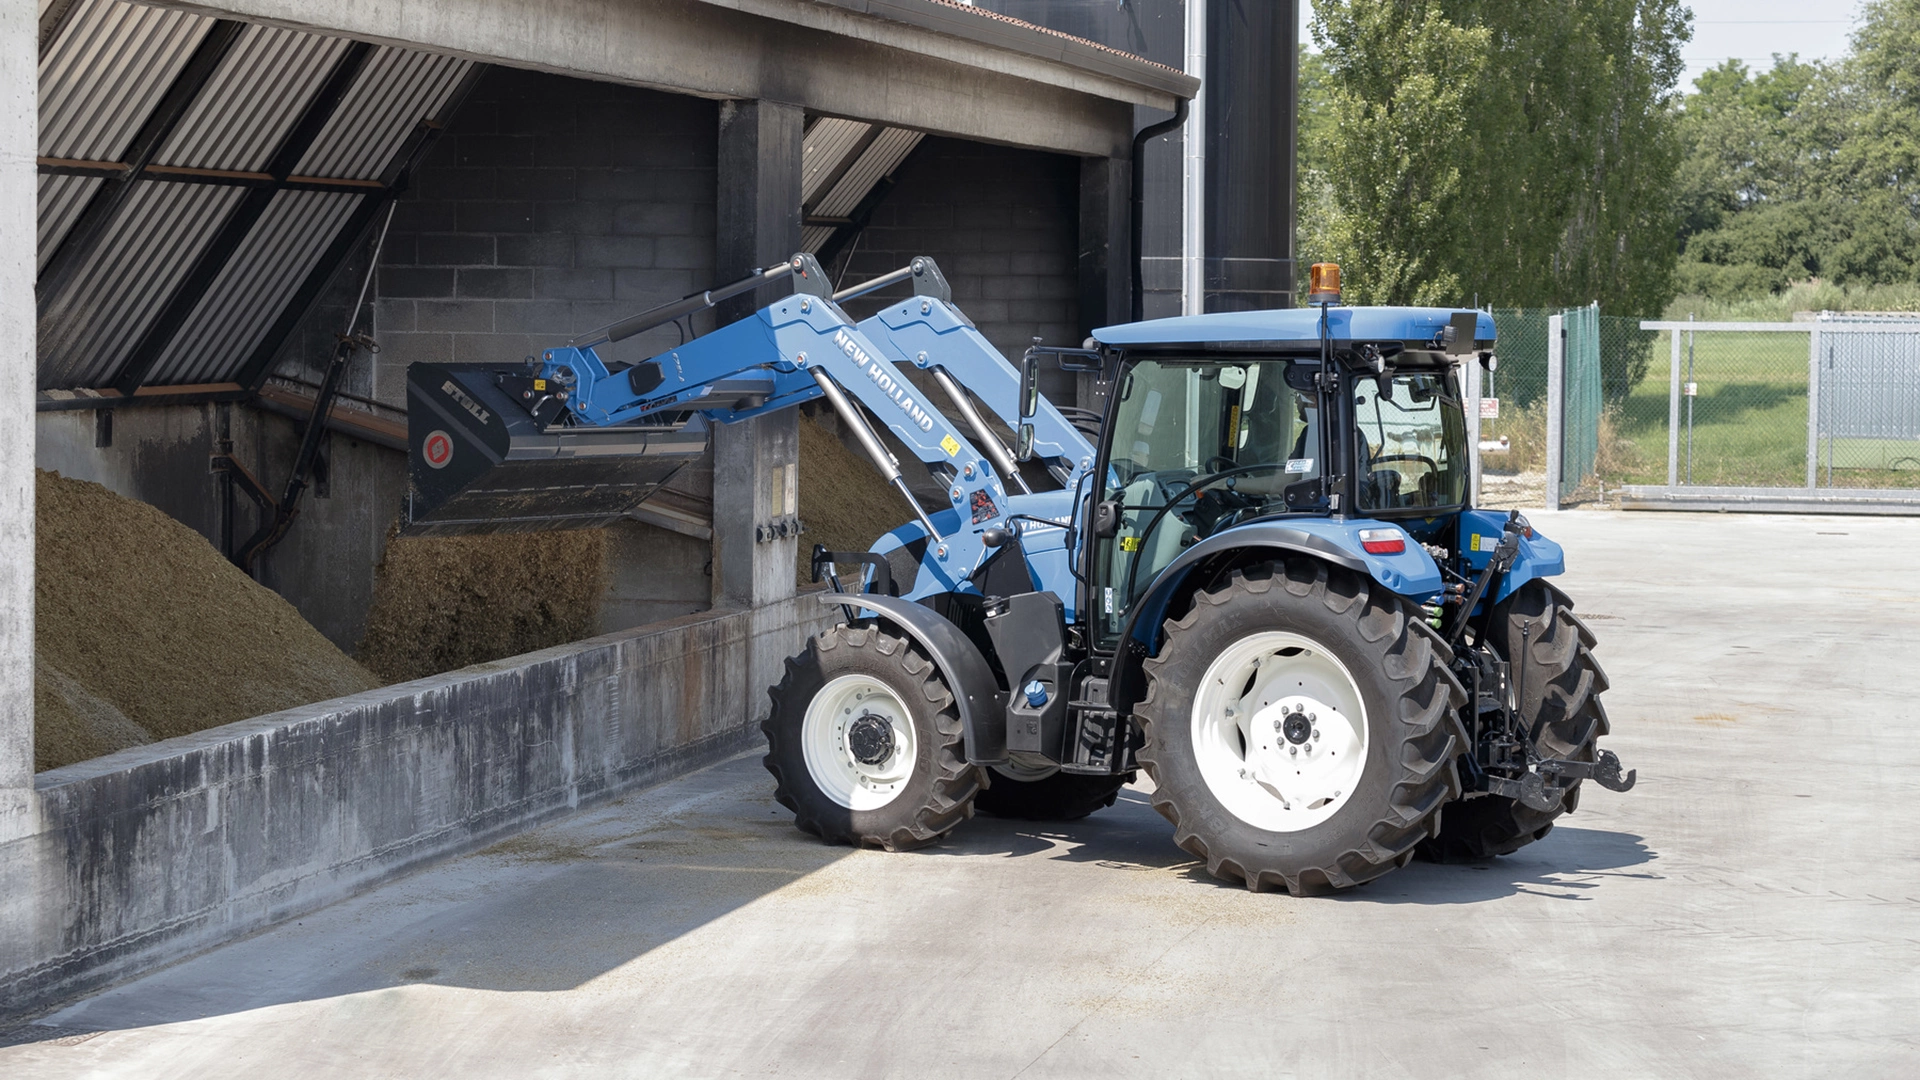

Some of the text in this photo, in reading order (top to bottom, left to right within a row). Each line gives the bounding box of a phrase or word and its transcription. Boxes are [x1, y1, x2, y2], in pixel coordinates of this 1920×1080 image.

[441, 380, 491, 425] STOLL
[832, 329, 933, 433] NEW HOLLAND
